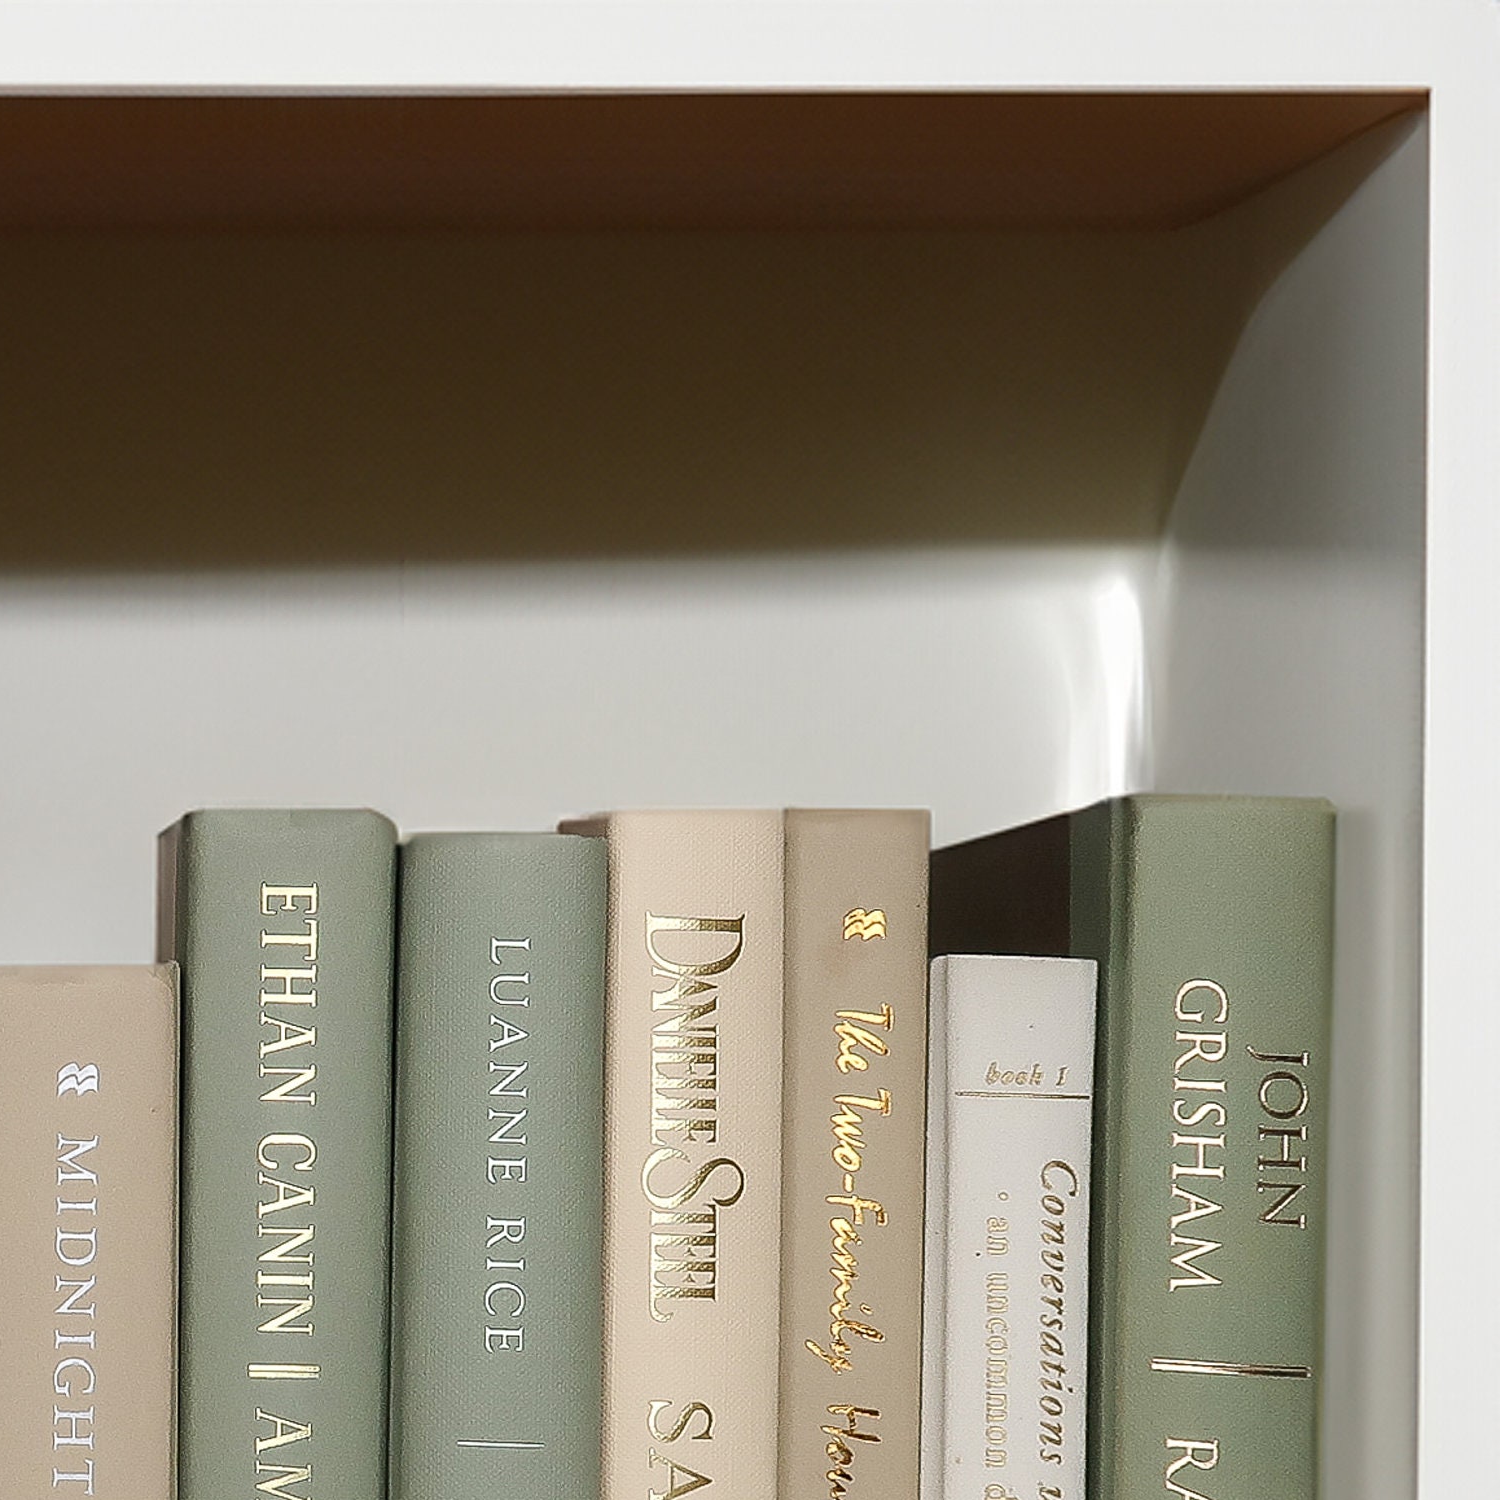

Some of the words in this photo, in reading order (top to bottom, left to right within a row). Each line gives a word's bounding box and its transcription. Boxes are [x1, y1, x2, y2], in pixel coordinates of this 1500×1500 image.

[257, 882, 319, 1107] ETHAN
[486, 936, 533, 1185] LUANNE
[644, 910, 747, 1149] DANIELLE
[833, 1002, 895, 1074] The
[985, 1061, 1043, 1086] book
[255, 1132, 318, 1338] CANIN
[641, 1145, 747, 1324] STEEL
[804, 1088, 893, 1375] Two-Family
[985, 1215, 1008, 1257] an
[1167, 977, 1230, 1293] GRISHAM
[1245, 1045, 1311, 1230] JOHN
[50, 1132, 100, 1497] MIDNIGHT
[482, 1215, 528, 1355] RICE
[983, 1271, 1009, 1470] uncommon
[1038, 1158, 1079, 1467] Conversations
